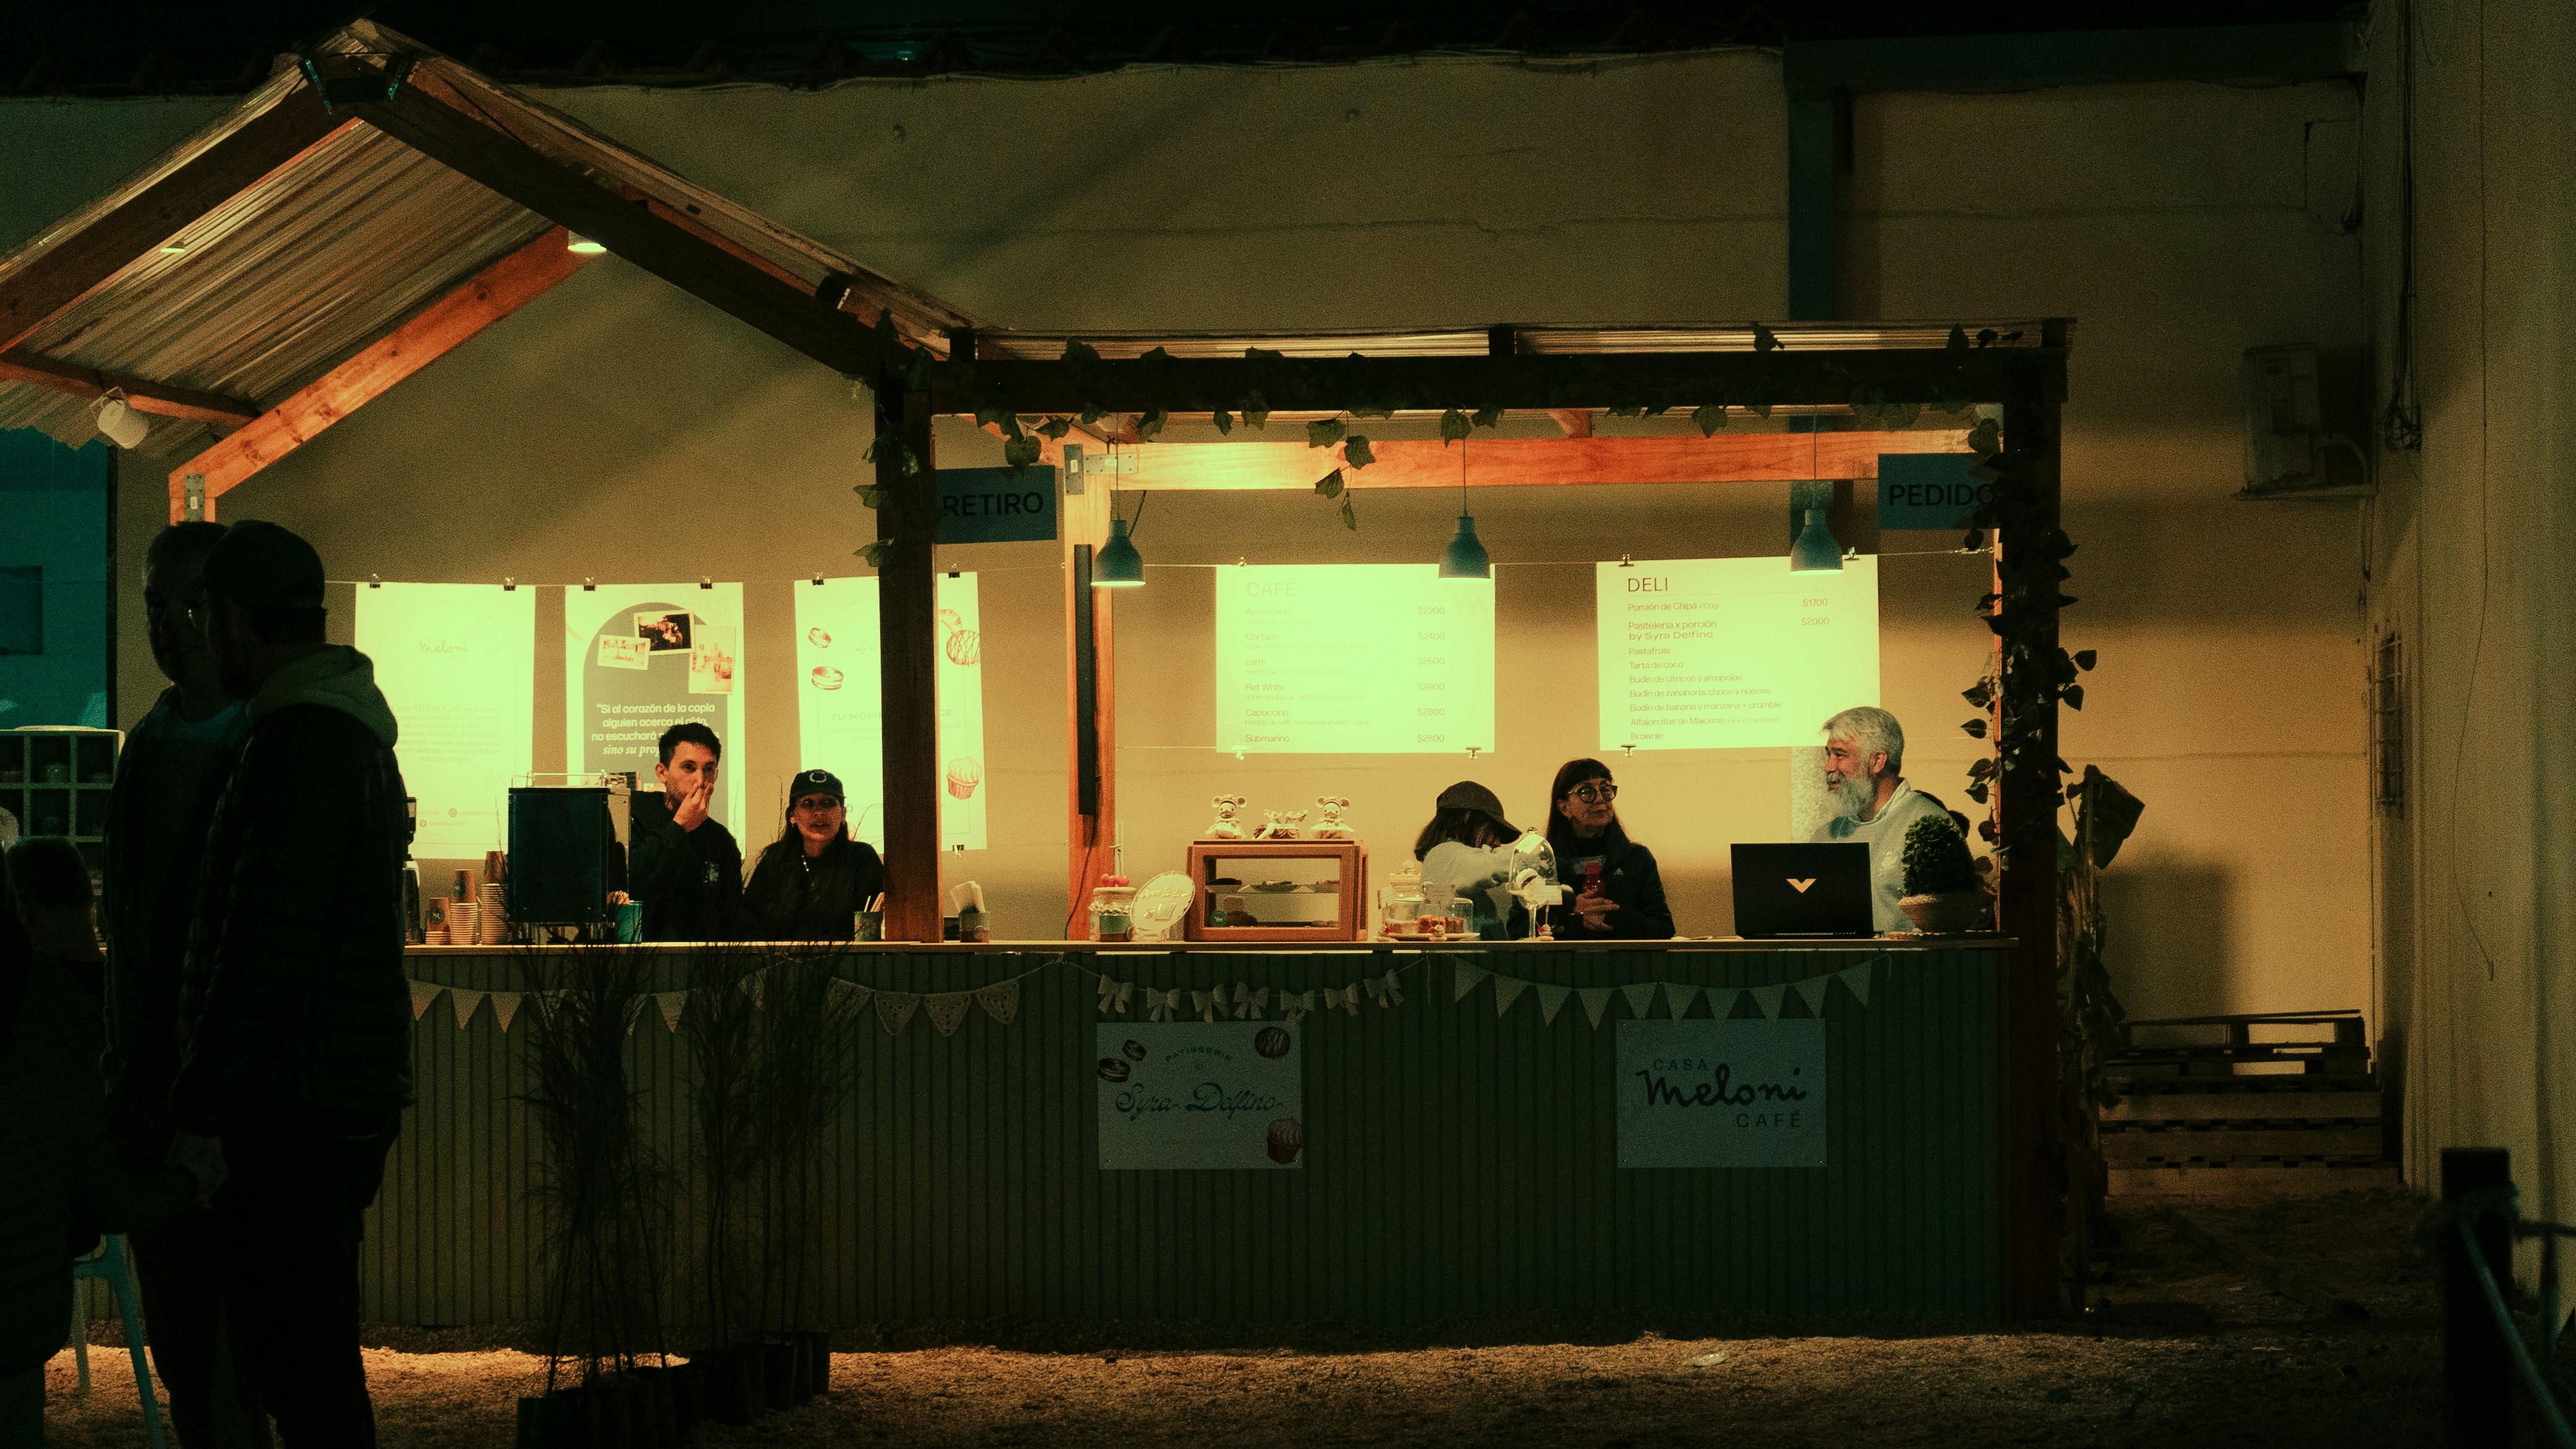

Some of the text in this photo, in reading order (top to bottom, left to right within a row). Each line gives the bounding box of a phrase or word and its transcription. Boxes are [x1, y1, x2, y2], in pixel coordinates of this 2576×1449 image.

[942, 491, 1044, 516] RETIRO
[1246, 578, 1296, 597] CAFÉ
[1628, 577, 1668, 592] DELI
[1628, 603, 1659, 611] Porción
[1661, 602, 1672, 610] de
[1673, 602, 1697, 611] Chipá
[1802, 597, 1828, 607] $1700
[1245, 607, 1291, 615] Americano
[1418, 606, 1445, 616] $2200
[1628, 620, 1674, 630] Pastelería
[1682, 620, 1716, 630] porción
[1801, 617, 1830, 626] $2000
[1245, 632, 1279, 641] Cortado
[1418, 632, 1445, 641] $2400
[1629, 630, 1713, 641] by Syra Delfino
[1629, 647, 1670, 655] Pastafrola
[1417, 656, 1445, 666] $2600
[1629, 661, 1650, 669] Tarta
[1651, 661, 1662, 669] de
[1629, 673, 1743, 684] Budín de cítricos y amapolas
[1417, 682, 1445, 692] $2800
[1630, 689, 1652, 698] Budín
[1666, 689, 1707, 697] zanahoria,
[612, 704, 621, 713] al
[622, 703, 662, 713] corazón
[663, 703, 676, 713] de
[677, 703, 687, 713] la
[1630, 703, 1653, 712] Budín
[1666, 703, 1696, 711] banana
[1748, 701, 1782, 709] crumble
[830, 712, 882, 721] TU MOME
[1245, 708, 1289, 718] Capuccino
[1417, 708, 1445, 718] $2800
[602, 718, 638, 730] alguien
[639, 718, 674, 727] acerca
[674, 717, 684, 726] el
[1630, 718, 1676, 728] Alfajorcitos
[1690, 716, 1724, 724] Maicena
[591, 733, 604, 741] no
[606, 731, 657, 741] escuchará
[1245, 734, 1290, 742] Submarino
[1417, 734, 1445, 743] $2800
[1631, 732, 1664, 740] Brownie
[602, 744, 659, 758] sino su prop
[1653, 1058, 1708, 1071] CASA
[1635, 1063, 1807, 1107] Meloni
[1115, 1082, 1180, 1122] Syra
[1736, 1109, 1801, 1128] CAFÉ
